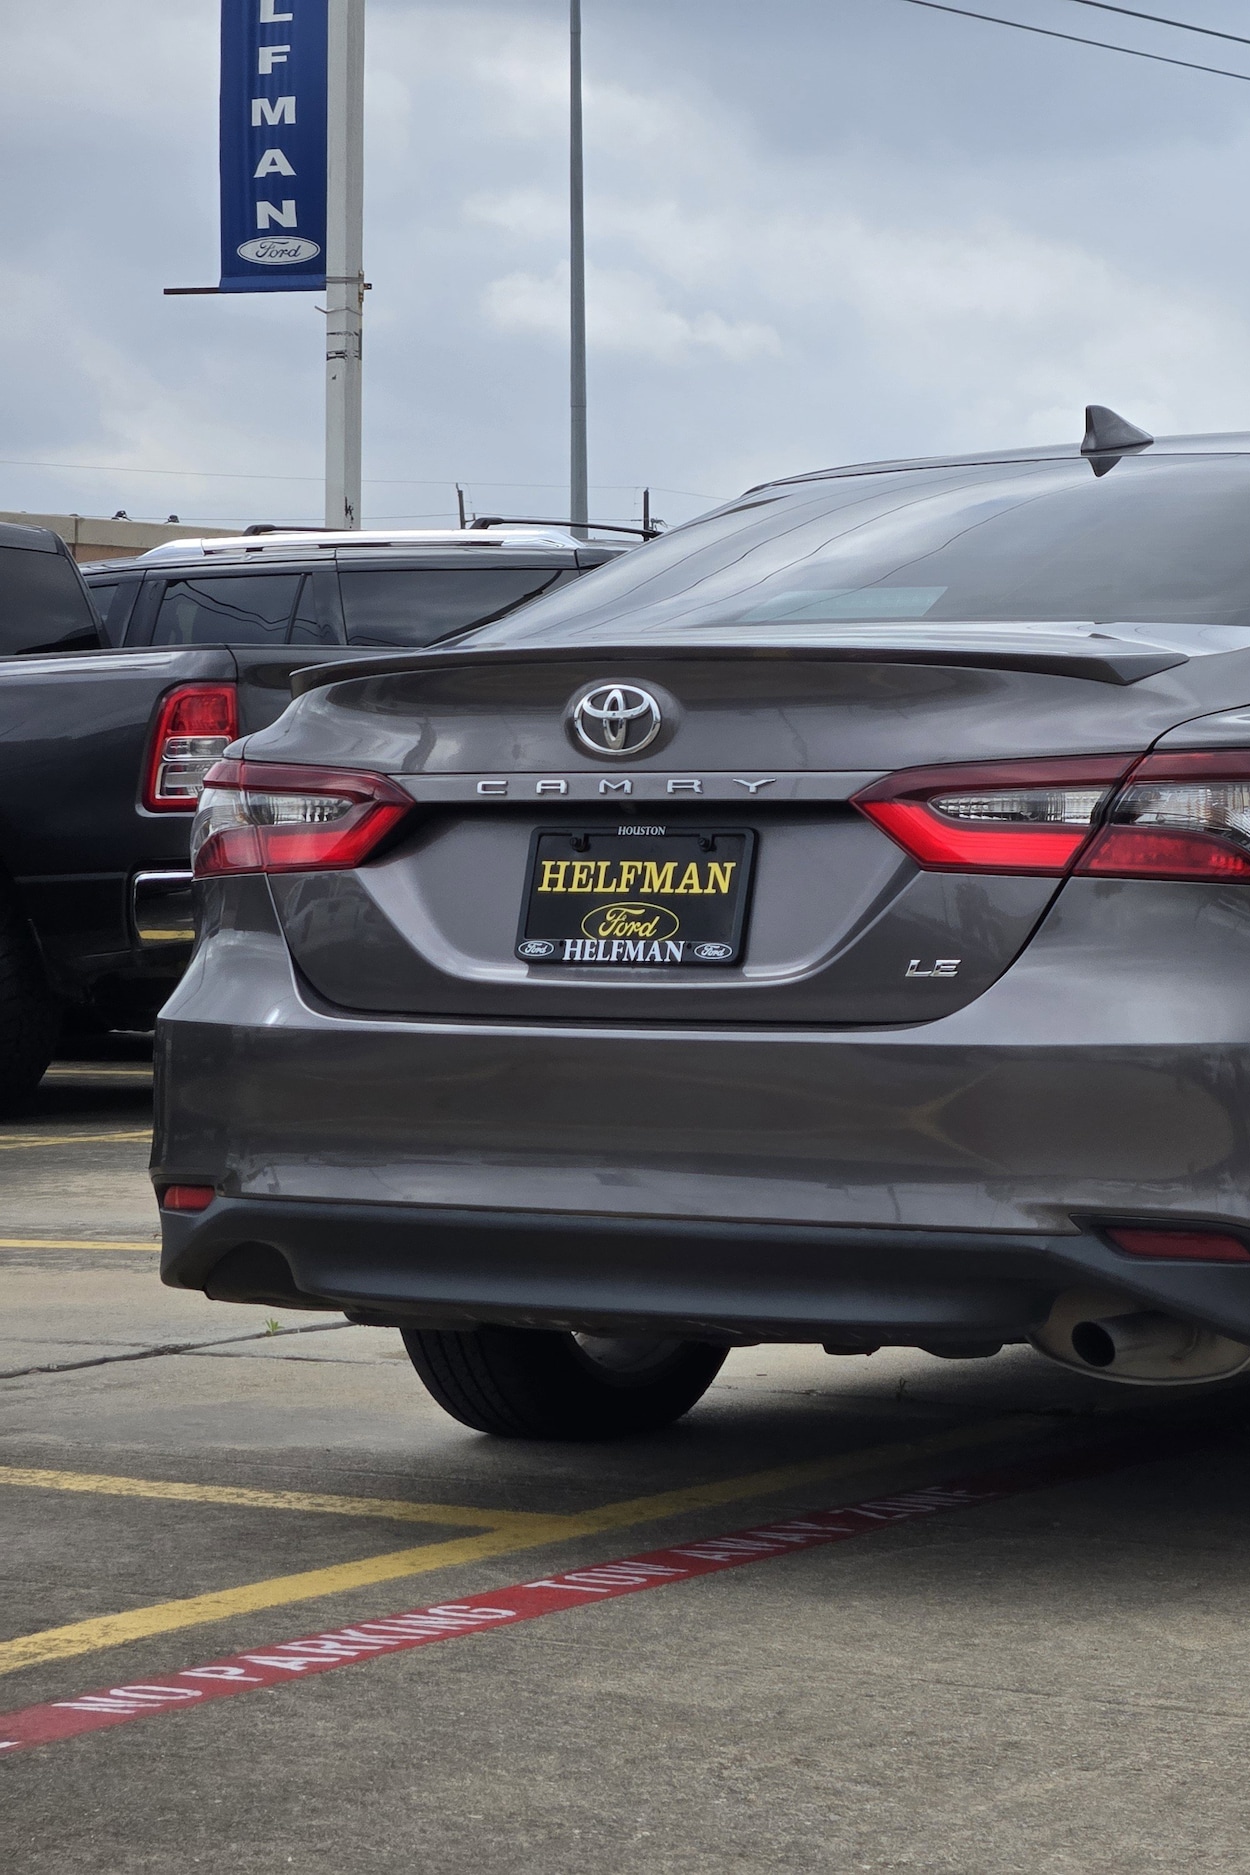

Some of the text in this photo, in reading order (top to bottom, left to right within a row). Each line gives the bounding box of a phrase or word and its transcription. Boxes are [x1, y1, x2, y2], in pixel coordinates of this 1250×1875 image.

[254, 241, 302, 258] Ford
[477, 778, 777, 794] CAMRY
[617, 826, 667, 836] HOUSTON
[537, 860, 737, 894] HELFMAN
[598, 907, 661, 938] Ford
[524, 939, 726, 963] Ford HELFMAN Ford
[905, 959, 962, 977] LE
[52, 1684, 203, 1714] NO
[179, 1604, 518, 1683] PARKING
[522, 1560, 689, 1594] TOW
[668, 1520, 855, 1562] AWAY
